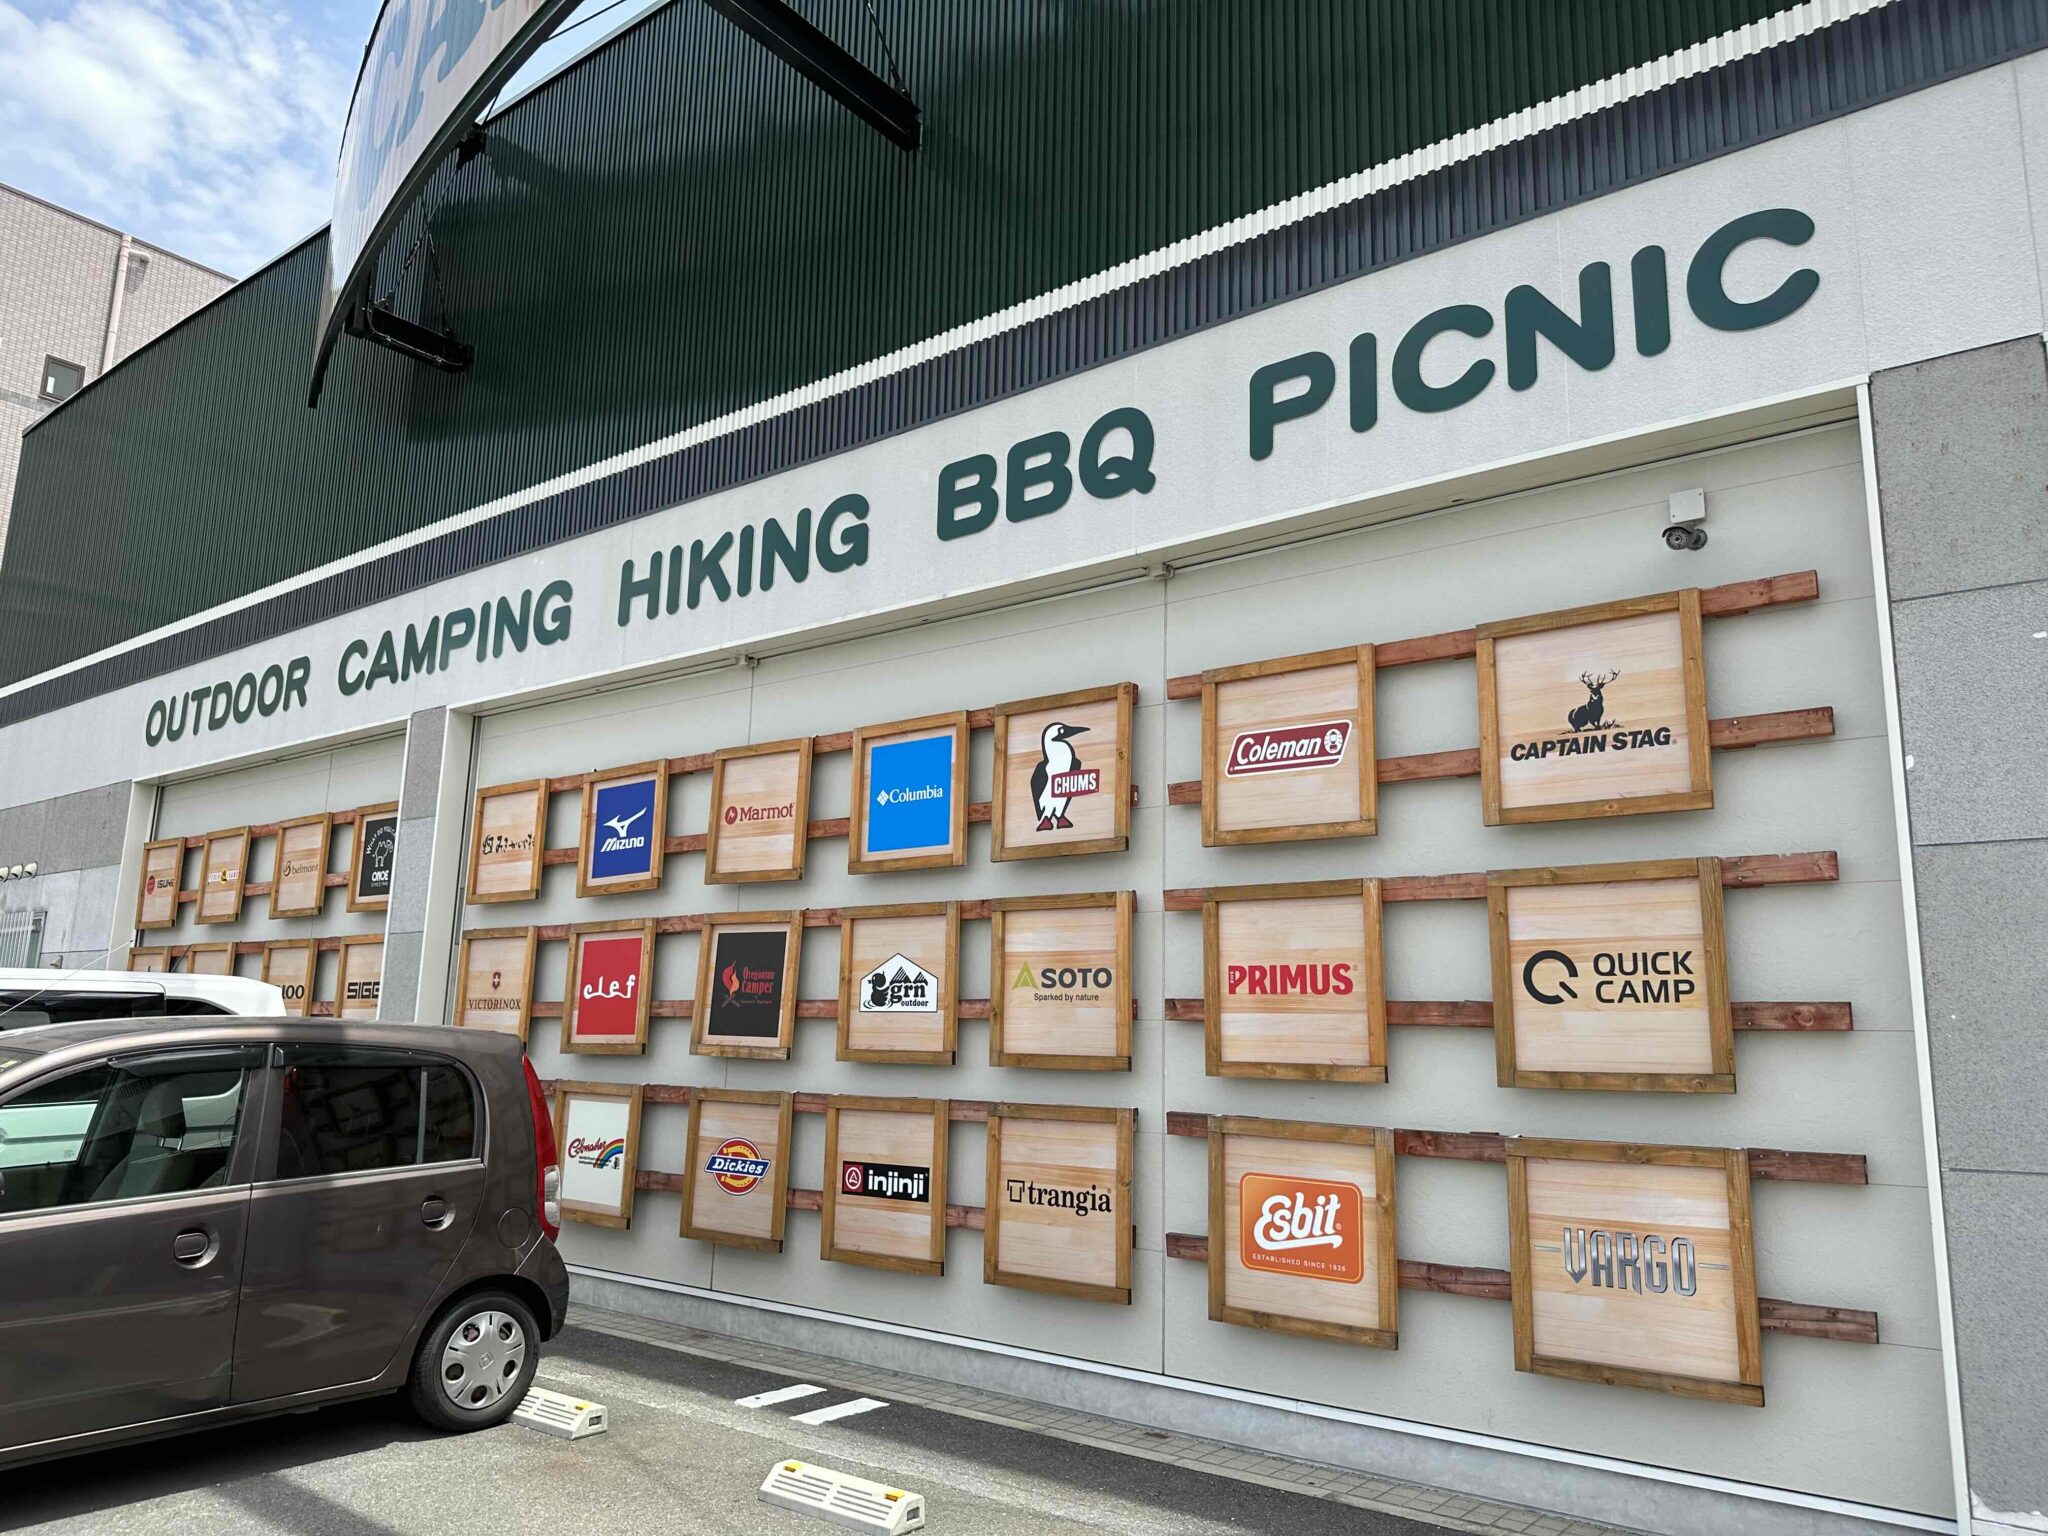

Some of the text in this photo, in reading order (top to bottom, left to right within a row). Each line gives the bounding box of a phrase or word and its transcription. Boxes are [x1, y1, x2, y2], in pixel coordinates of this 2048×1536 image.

[145, 208, 1820, 747] OUTDOOR CAMPING HIKING BBQ PICNIC
[1237, 736, 1322, 765] Coleman
[1510, 727, 1671, 761] CAPTAIN STAG
[889, 785, 943, 803] Columbia
[1054, 772, 1097, 795] CHUMS
[739, 804, 794, 821] Marmot
[291, 864, 318, 874] belmont
[1593, 951, 1694, 976] QUICK
[583, 974, 636, 999] clef
[742, 980, 774, 995] Camper
[1041, 968, 1112, 988] SOTO
[1228, 963, 1353, 995] PRIMUS
[889, 982, 926, 1003] grn
[1034, 993, 1099, 1002] Sparked by nature
[1595, 979, 1695, 1003] CAMP
[469, 999, 521, 1010] VICTORINOX
[900, 999, 928, 1007] outdoor
[711, 1158, 765, 1174] Dickies
[868, 1170, 924, 1198] injinji
[1028, 1181, 1112, 1216] trangia
[1254, 1192, 1343, 1250] Esbit
[1252, 1253, 1300, 1265] ESTABLISHED
[1303, 1260, 1325, 1269] SINCE
[1563, 1227, 1697, 1296] VARGO
